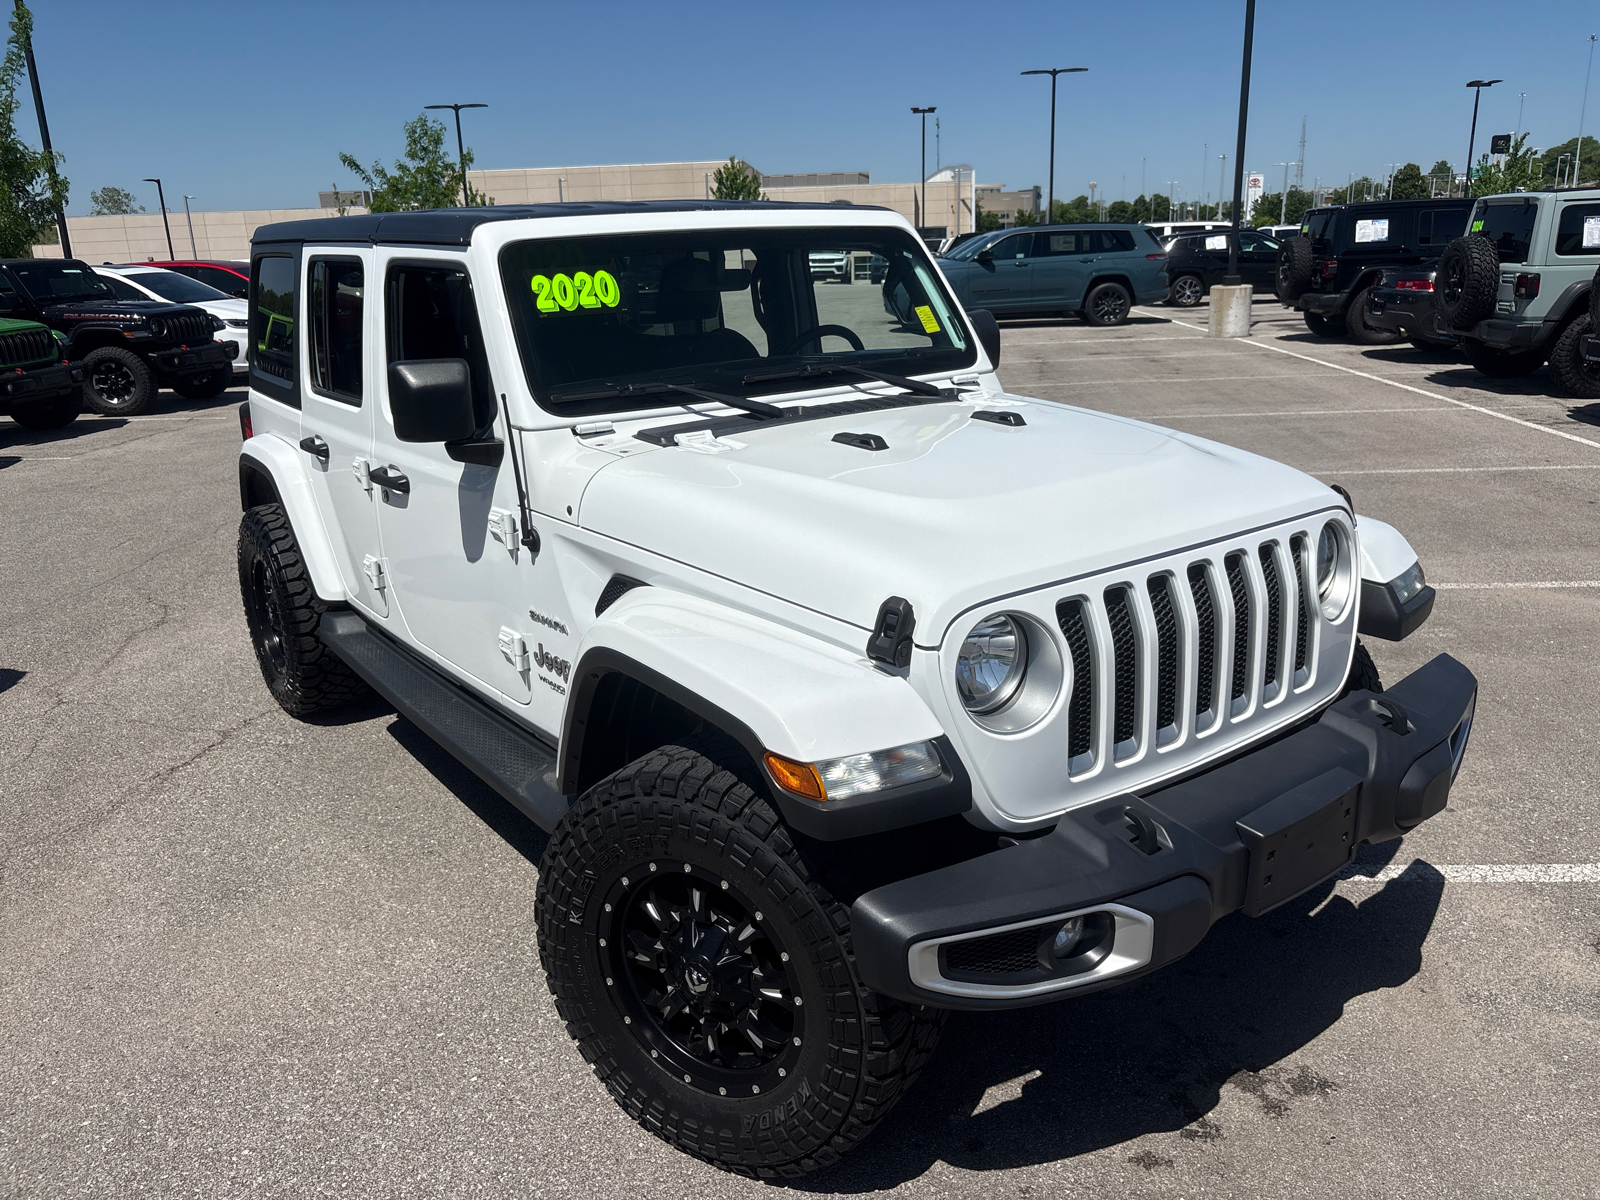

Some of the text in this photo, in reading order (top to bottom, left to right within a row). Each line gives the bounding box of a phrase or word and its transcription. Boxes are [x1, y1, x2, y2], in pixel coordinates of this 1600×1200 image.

[531, 270, 620, 313] 2020
[533, 642, 571, 684] Jeep
[569, 843, 627, 926] KLEVER
[742, 1077, 812, 1134] KENDA
